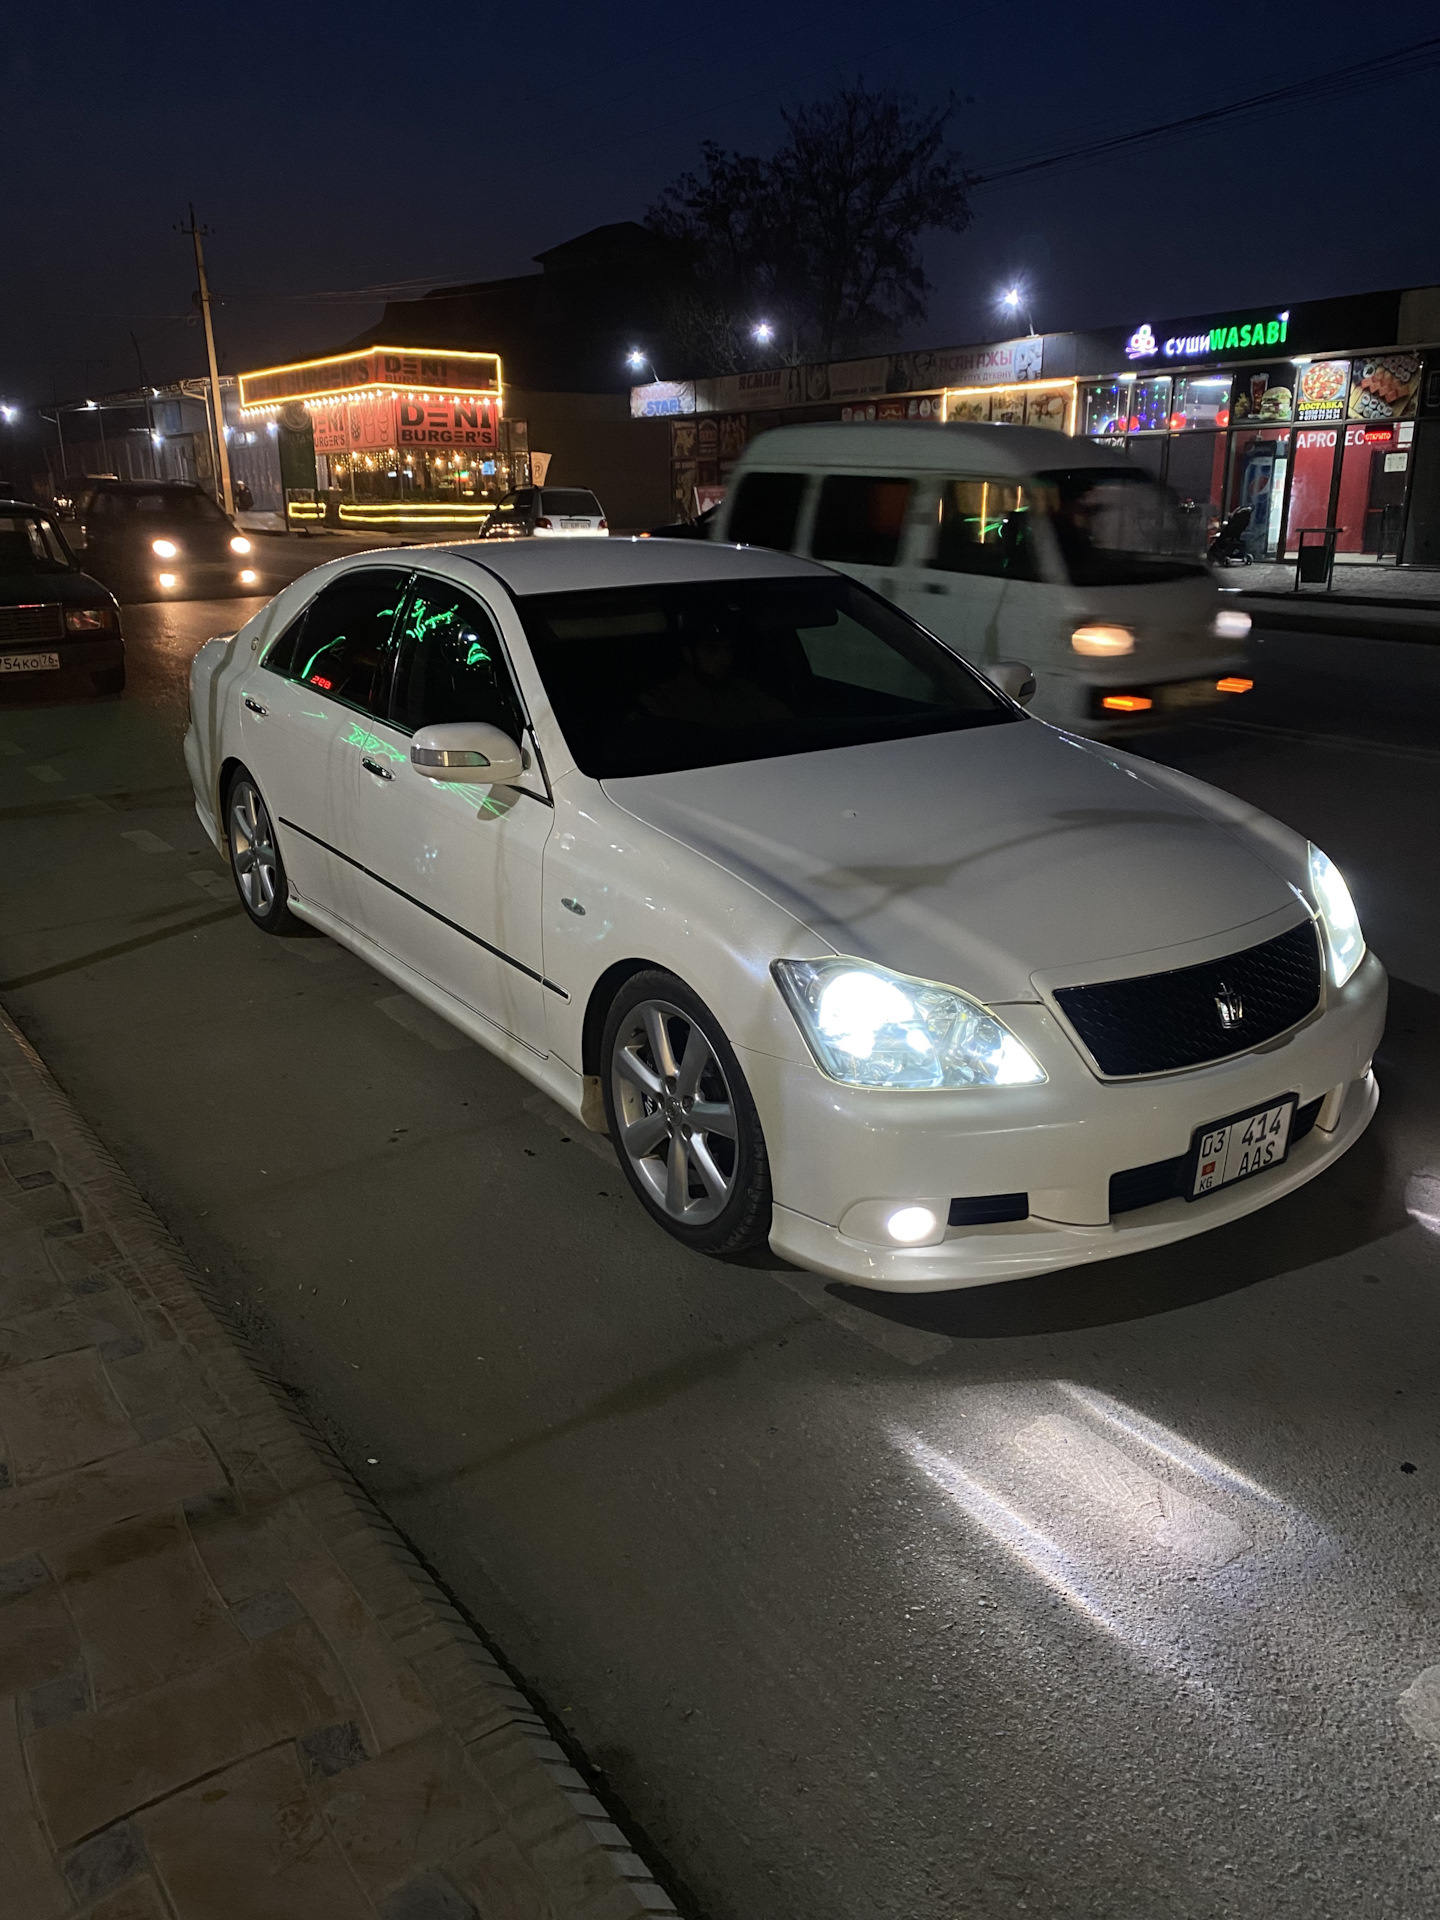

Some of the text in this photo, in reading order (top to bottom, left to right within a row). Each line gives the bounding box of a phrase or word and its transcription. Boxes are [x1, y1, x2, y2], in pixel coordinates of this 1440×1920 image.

[384, 355, 448, 377] DENI
[401, 402, 492, 429] DENI
[1298, 401, 1344, 412] ДОСТАВКА
[401, 429, 492, 444] BURGER'S
[1241, 1106, 1284, 1147] 414
[1201, 1129, 1226, 1159] 03
[1238, 1140, 1276, 1176] AAS
[1198, 1176, 1213, 1192] KG
